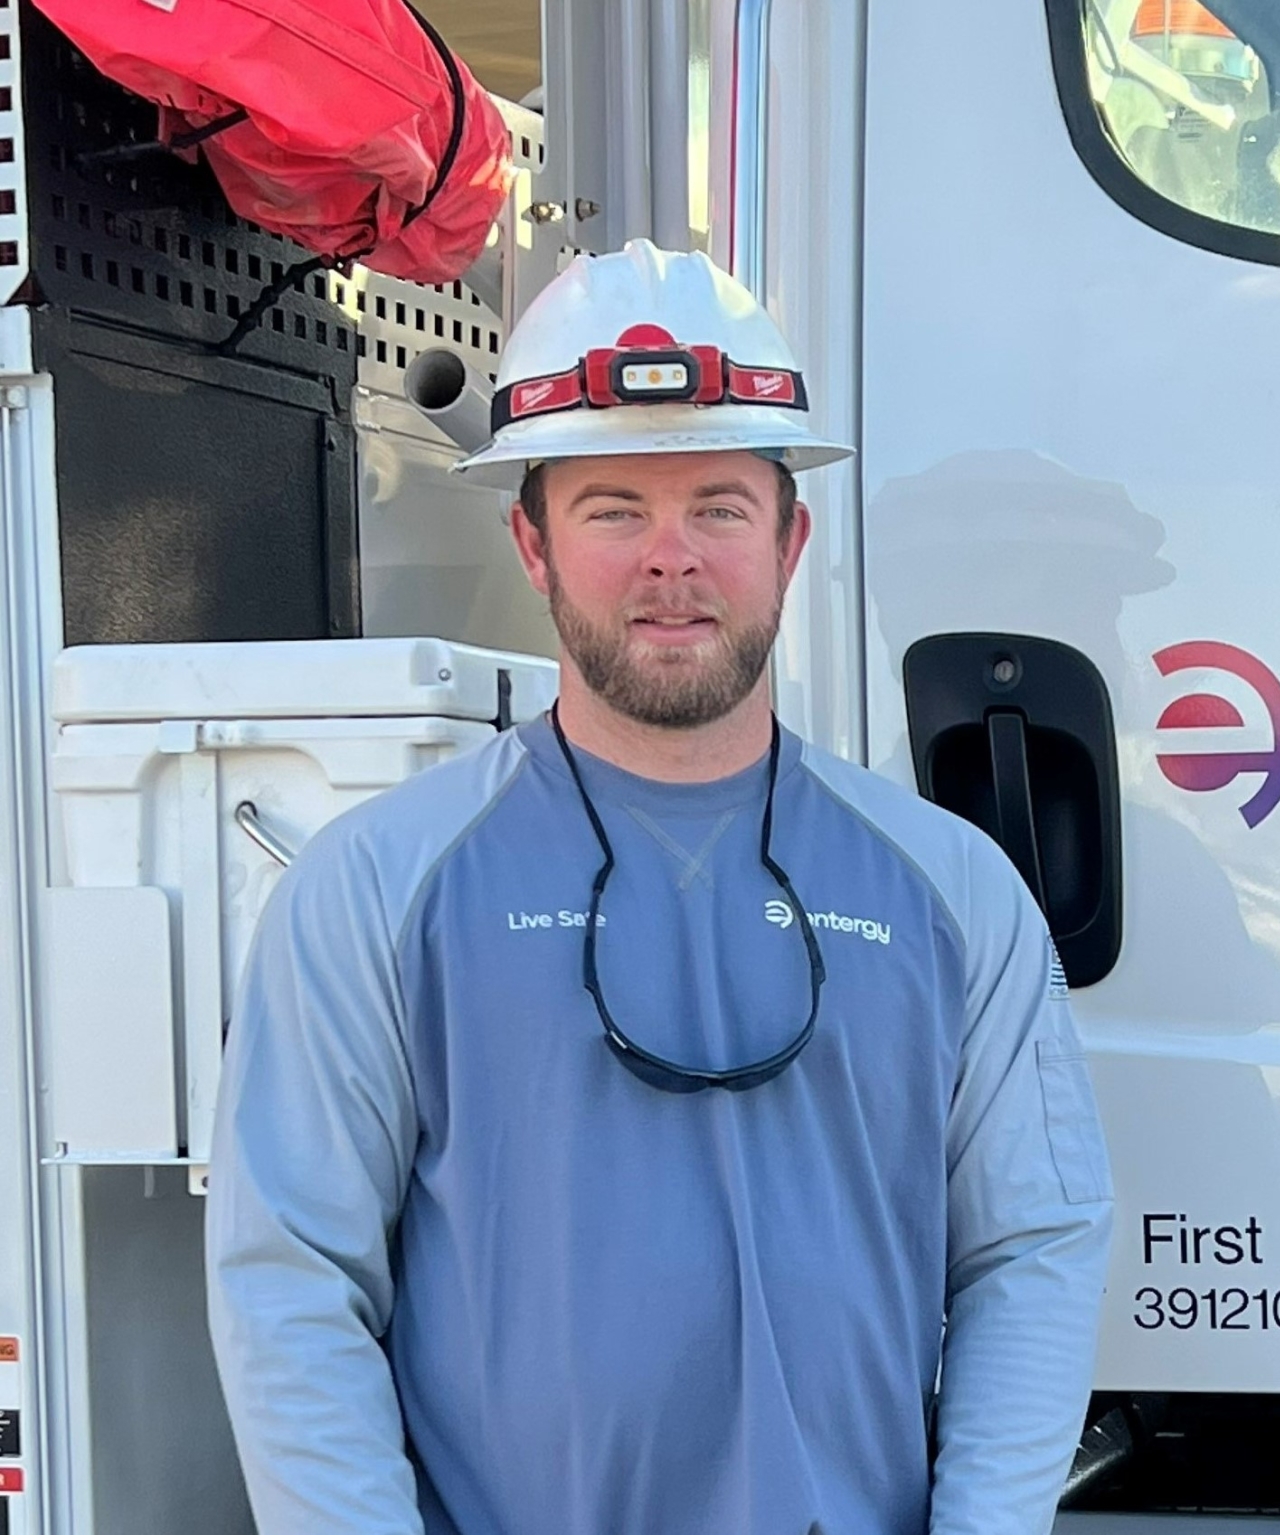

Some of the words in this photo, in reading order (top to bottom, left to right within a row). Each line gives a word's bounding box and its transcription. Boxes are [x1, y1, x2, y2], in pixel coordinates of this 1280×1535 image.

[507, 911, 553, 930] Live
[557, 909, 607, 928] Sae
[1142, 1213, 1264, 1265] First
